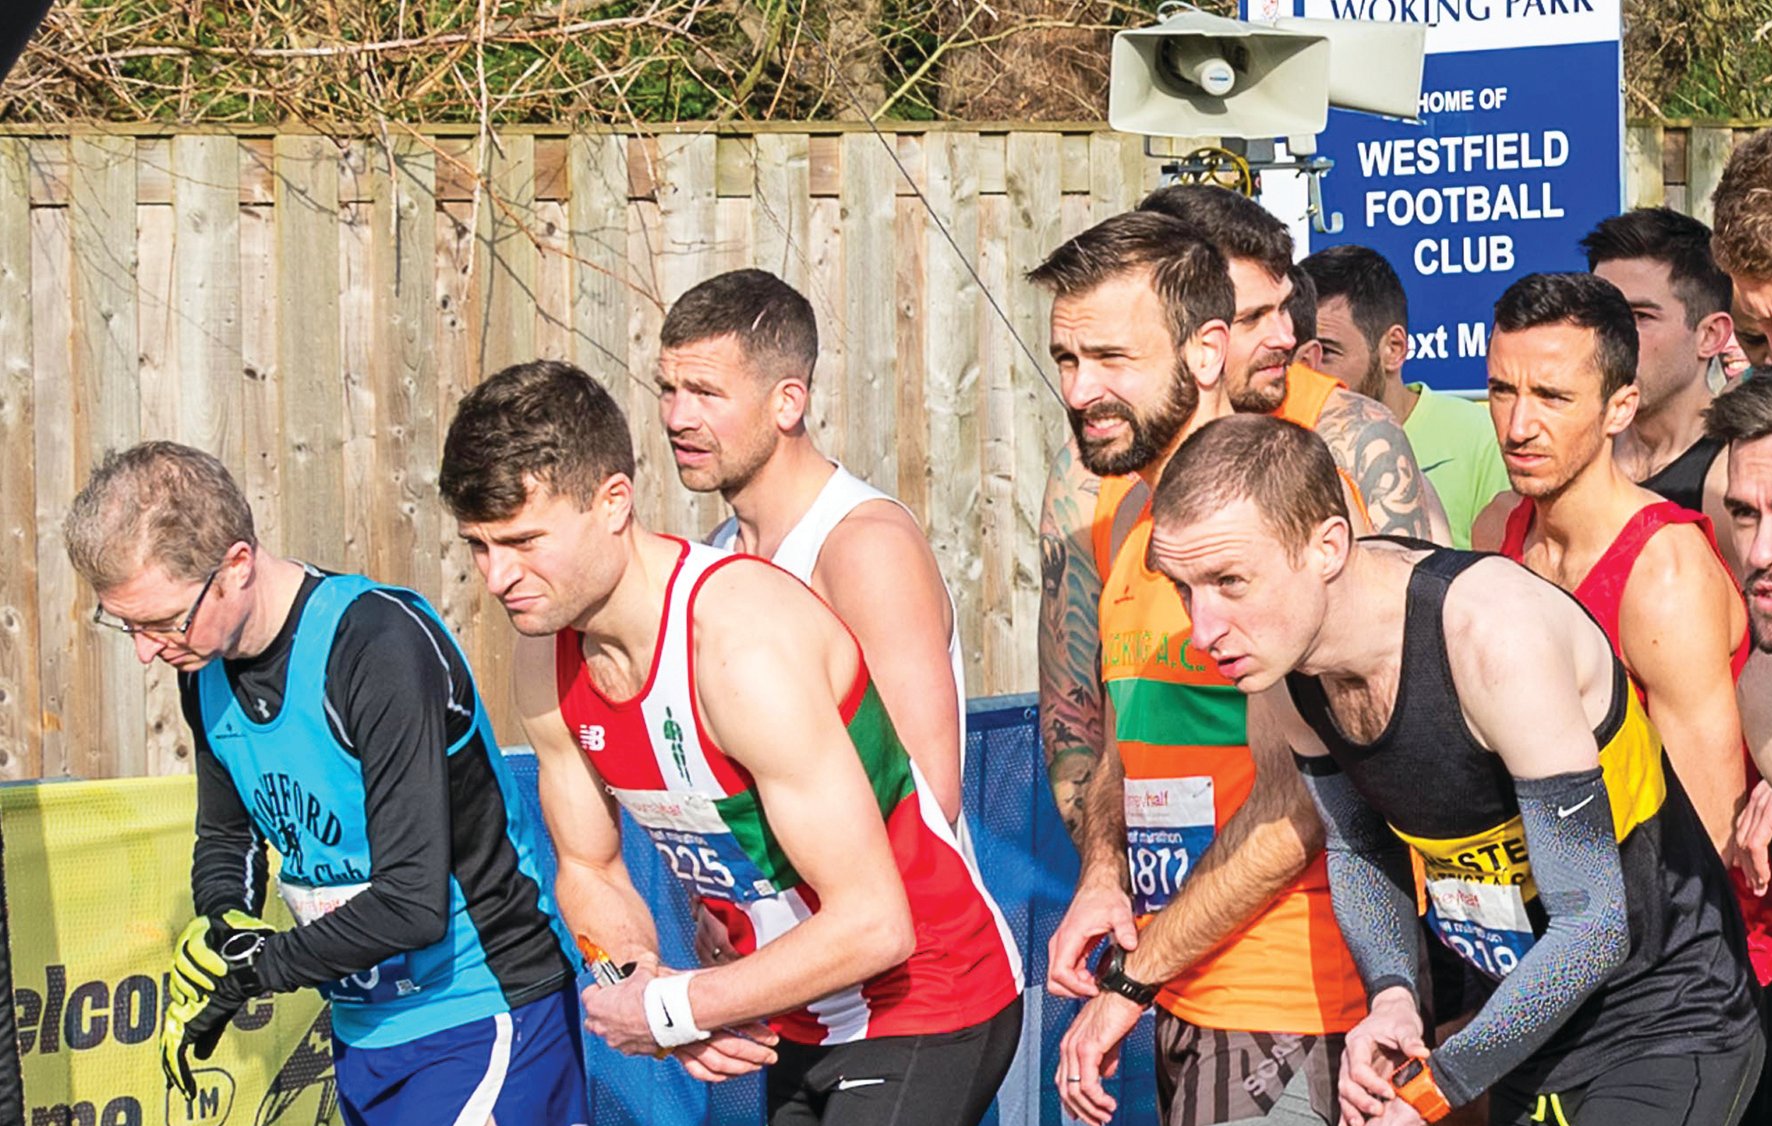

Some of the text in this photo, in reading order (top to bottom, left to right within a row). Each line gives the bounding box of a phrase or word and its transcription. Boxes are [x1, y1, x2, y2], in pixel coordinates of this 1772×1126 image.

[1418, 87, 1508, 114] HOME OF
[1357, 130, 1569, 177] WESTFIELD
[1365, 182, 1565, 227] FOOTBALL
[1413, 235, 1515, 275] CLUB
